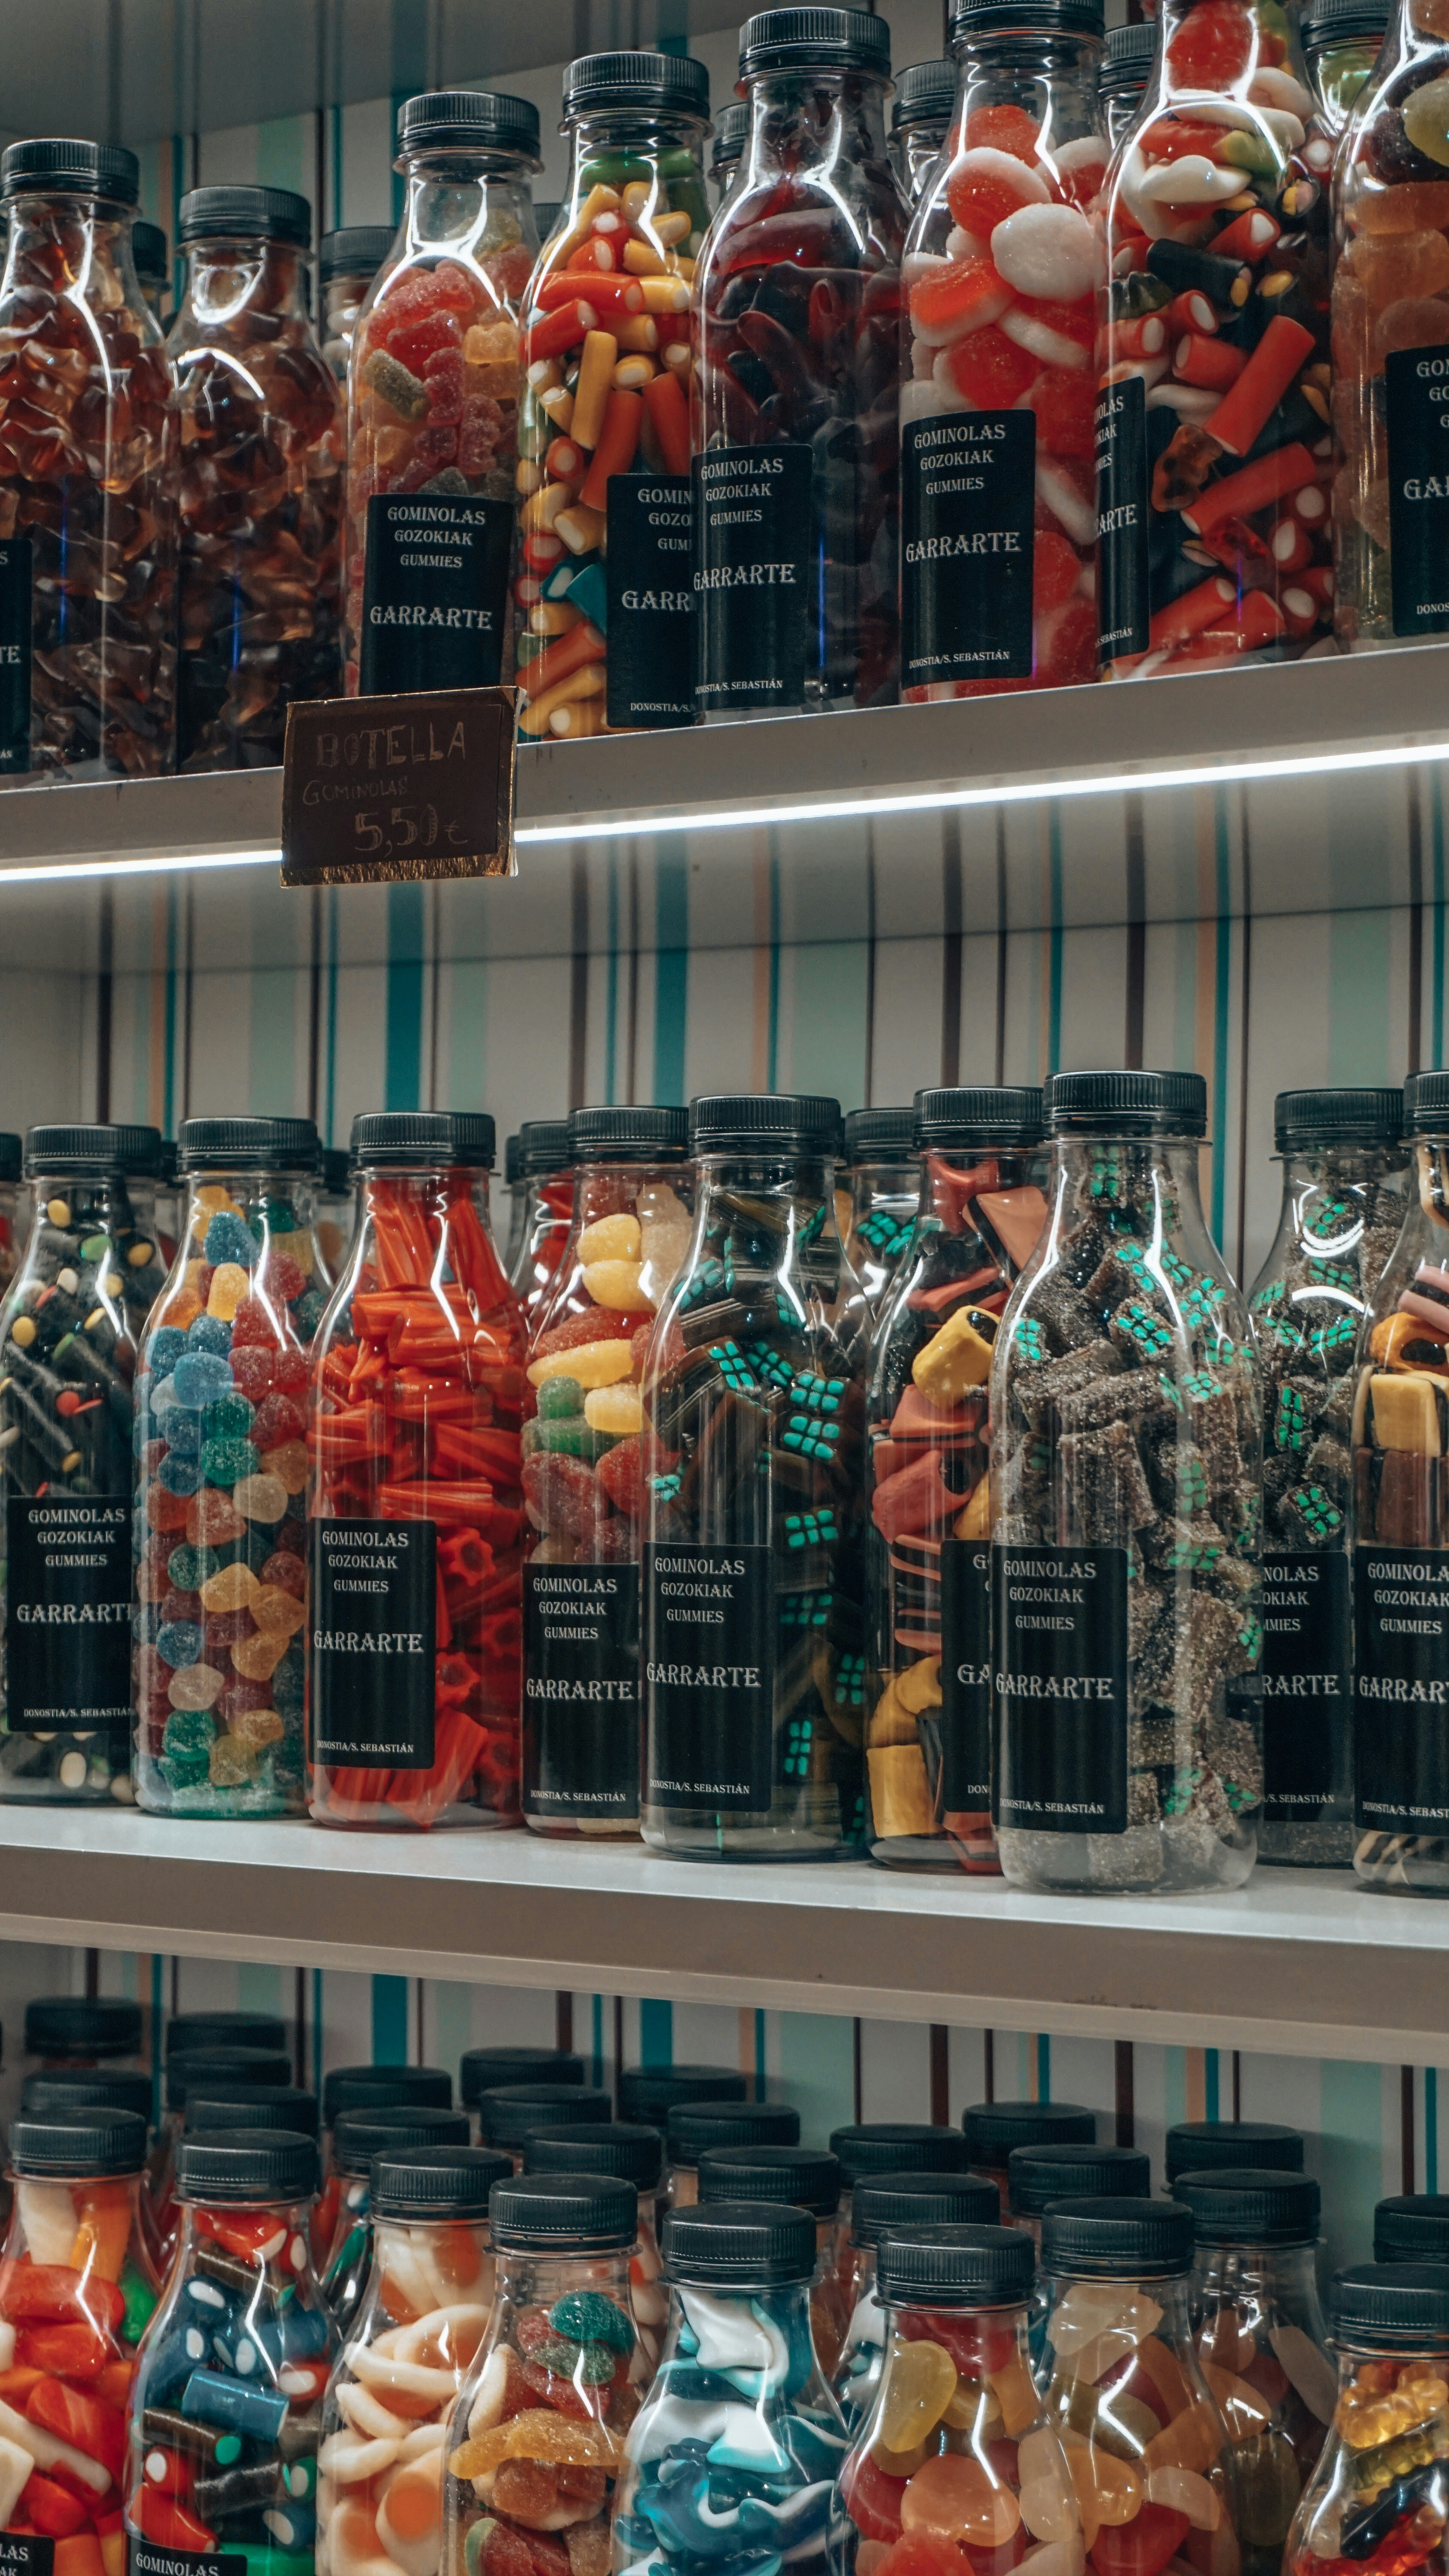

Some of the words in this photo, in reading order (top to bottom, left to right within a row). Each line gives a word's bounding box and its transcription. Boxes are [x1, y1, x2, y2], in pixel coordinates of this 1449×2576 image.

[914, 424, 1006, 449] GOMINOLAS
[701, 458, 784, 480] GOMINOLAS
[920, 450, 994, 471] GOZOKIAK
[706, 483, 772, 501] GOZOKIAK
[926, 477, 985, 495] GUMMIES
[638, 488, 691, 504] GOMIN
[388, 506, 486, 526] GOMINOLAS
[649, 513, 691, 526] GOZO
[710, 510, 762, 526] GUMMIES
[1097, 504, 1137, 537] ARTE
[395, 529, 473, 546] GOZOKIAK
[906, 532, 1022, 563] GARRARTE
[400, 554, 463, 568] GUMMIES
[694, 564, 796, 591] GARRARTE
[622, 590, 689, 612] GARR
[370, 605, 492, 630] GARRARTE
[909, 656, 951, 669] DONOSTIA/S.
[953, 649, 1010, 662] SEBASTIÁN
[731, 678, 782, 690] SEBASTIÁN
[316, 721, 465, 769] BOTELLA
[303, 776, 408, 805] GOMINOLAS
[28, 1508, 125, 1524] GOMINOLAS
[37, 1530, 115, 1545] GOZOKIAK
[323, 1531, 409, 1548] GOMINOLAS
[45, 1554, 108, 1567] GUMMIES
[328, 1554, 398, 1569] GOZOKIAK
[655, 1557, 745, 1576] GOMINOLAS
[1003, 1560, 1097, 1579] GOMINOLAS
[1264, 1566, 1320, 1582] NOLAS
[1368, 1562, 1449, 1582] GOMINOLA
[334, 1579, 389, 1592] GUMMIES
[533, 1577, 617, 1594] GOMINOLAS
[661, 1582, 734, 1598] GOZOKIAK
[1009, 1587, 1084, 1603] GOZOKIAK
[1263, 1591, 1309, 1606] OKIAK
[539, 1601, 607, 1616] GOZOKIAK
[667, 1608, 724, 1623] GUMMIES
[1015, 1615, 1075, 1630] GUMMIES
[1380, 1618, 1443, 1634] GUMMIES
[544, 1627, 599, 1639] GUMMIES
[314, 1631, 424, 1653] GARRARTE
[646, 1662, 761, 1688] GARRARTE
[527, 1678, 634, 1701] GARRARTE
[996, 1672, 1115, 1699] GARRARTE
[1262, 1674, 1342, 1696] RARTE
[1359, 1675, 1449, 1704] GARRAR
[24, 1708, 78, 1719] DONOSTIA/S.
[80, 1706, 130, 1717] SEBASTIÁ
[317, 1739, 358, 1752] DONOSTIA/S.
[361, 1741, 414, 1753] SEBASTIÁN
[649, 1778, 692, 1792] DONOSTIA/S.
[694, 1781, 750, 1795] SEBASTIÁN
[530, 1789, 571, 1801] DONOSTIA/S.
[573, 1790, 626, 1802] SEBASTIÁN
[1279, 1793, 1335, 1804] SEBASTIÁN
[1045, 1801, 1104, 1815] SEBASTIÁN
[1410, 1806, 1449, 1819] SEBAST
